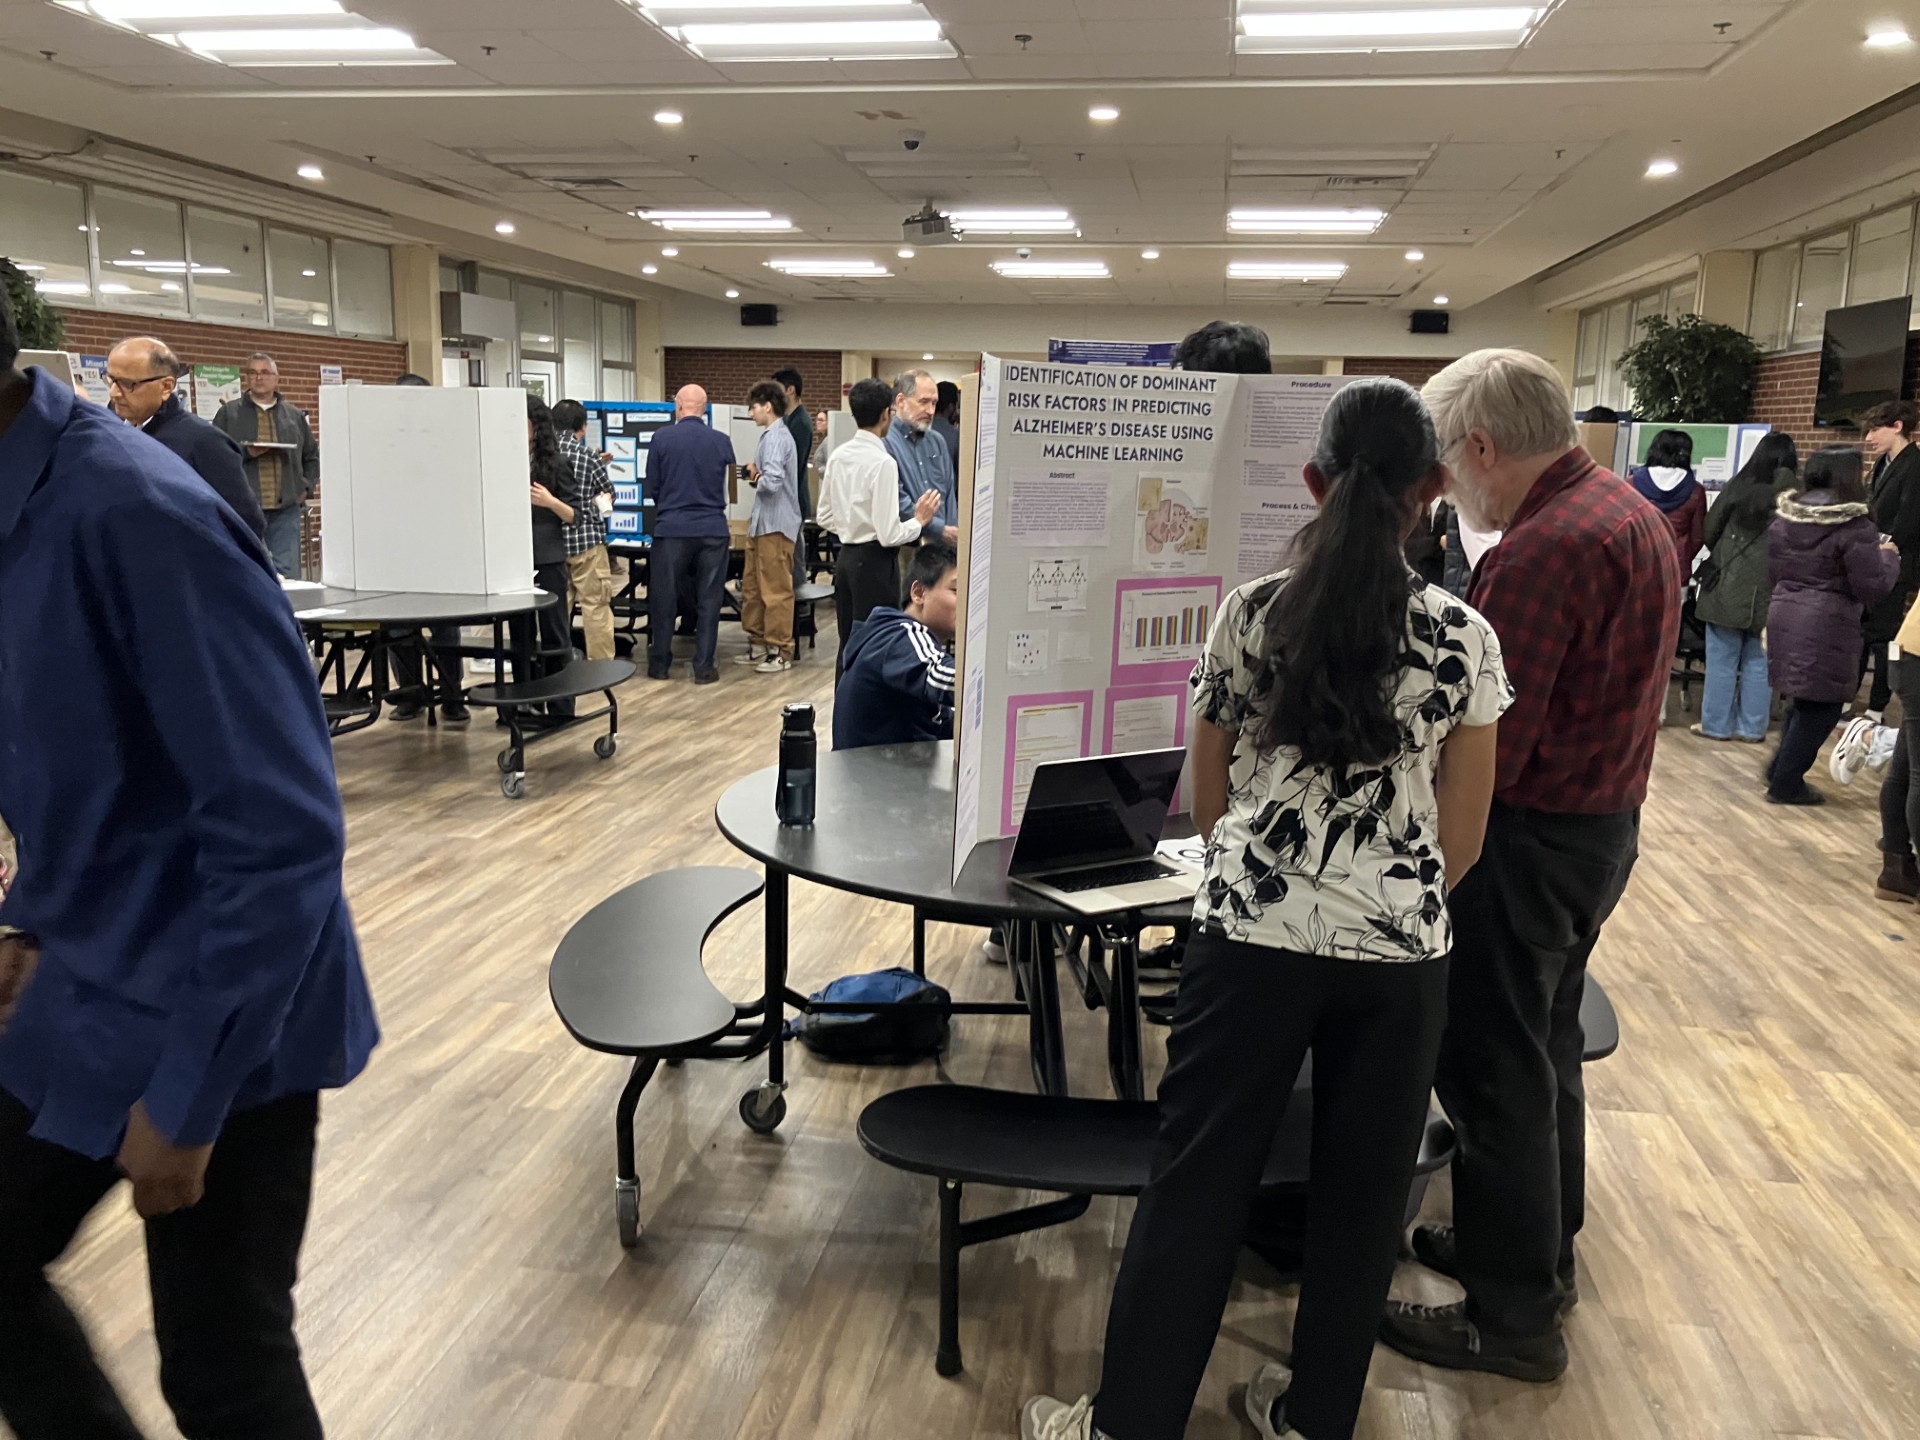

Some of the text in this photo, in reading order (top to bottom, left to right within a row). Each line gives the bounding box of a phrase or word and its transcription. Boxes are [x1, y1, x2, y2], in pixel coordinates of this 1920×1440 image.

[1005, 365, 1217, 392] IDENTIFICATION OF DOMINANT
[1008, 392, 1212, 416] RISK FACTORS IN PREDICTING
[1013, 417, 1214, 441] ALZHEIMER'S DISEASE USING
[1043, 443, 1184, 462] MACHINE LEARNING
[1261, 502, 1291, 510] Process
